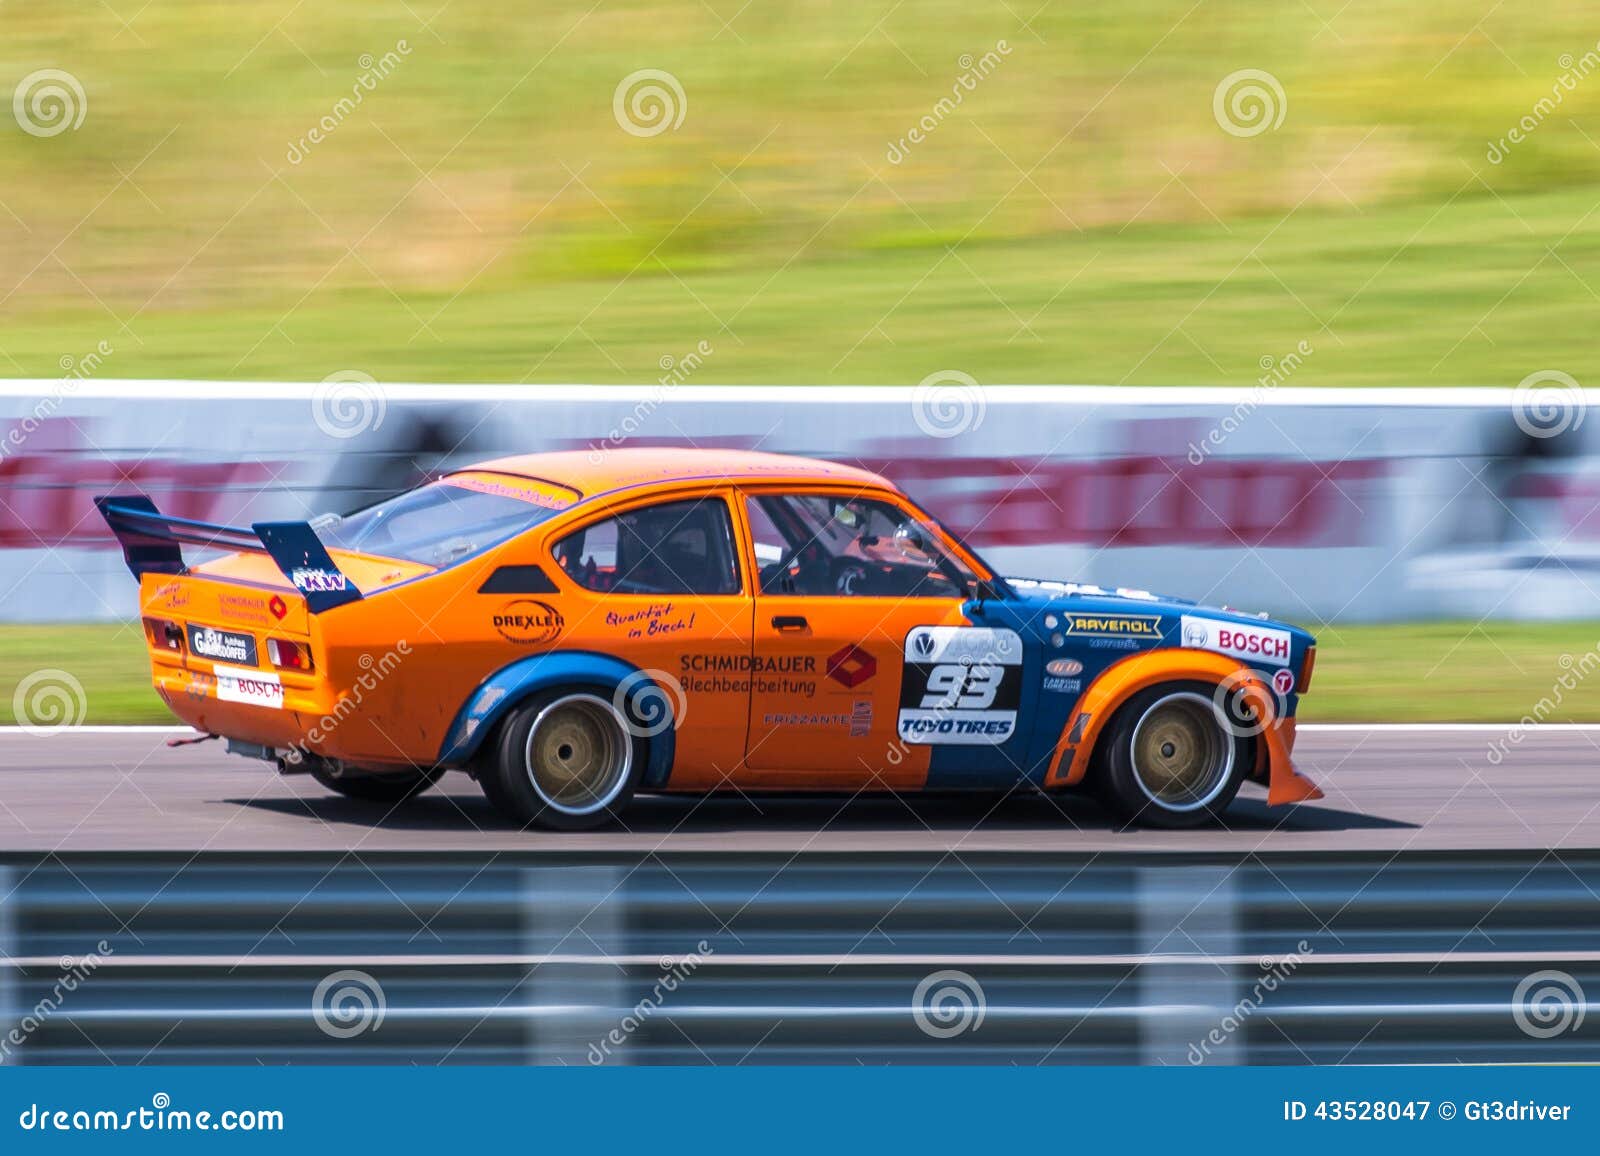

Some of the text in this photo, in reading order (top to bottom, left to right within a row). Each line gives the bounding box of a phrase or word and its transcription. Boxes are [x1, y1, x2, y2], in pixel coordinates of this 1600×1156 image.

[302, 573, 346, 592] KW
[493, 615, 565, 630] DREXLER
[605, 603, 673, 625] Qualität
[628, 612, 696, 639] in Blech!
[1075, 618, 1153, 633] RAVENOL
[1218, 629, 1290, 659] BOSCH
[680, 654, 816, 673] SCHMIDBAUER
[237, 678, 281, 699] BOSCH
[679, 675, 817, 698] Blechbearbeitung
[919, 663, 1006, 709] 93
[764, 713, 850, 726] FRIZZANTE
[902, 718, 1012, 735] TOYO TIRES
